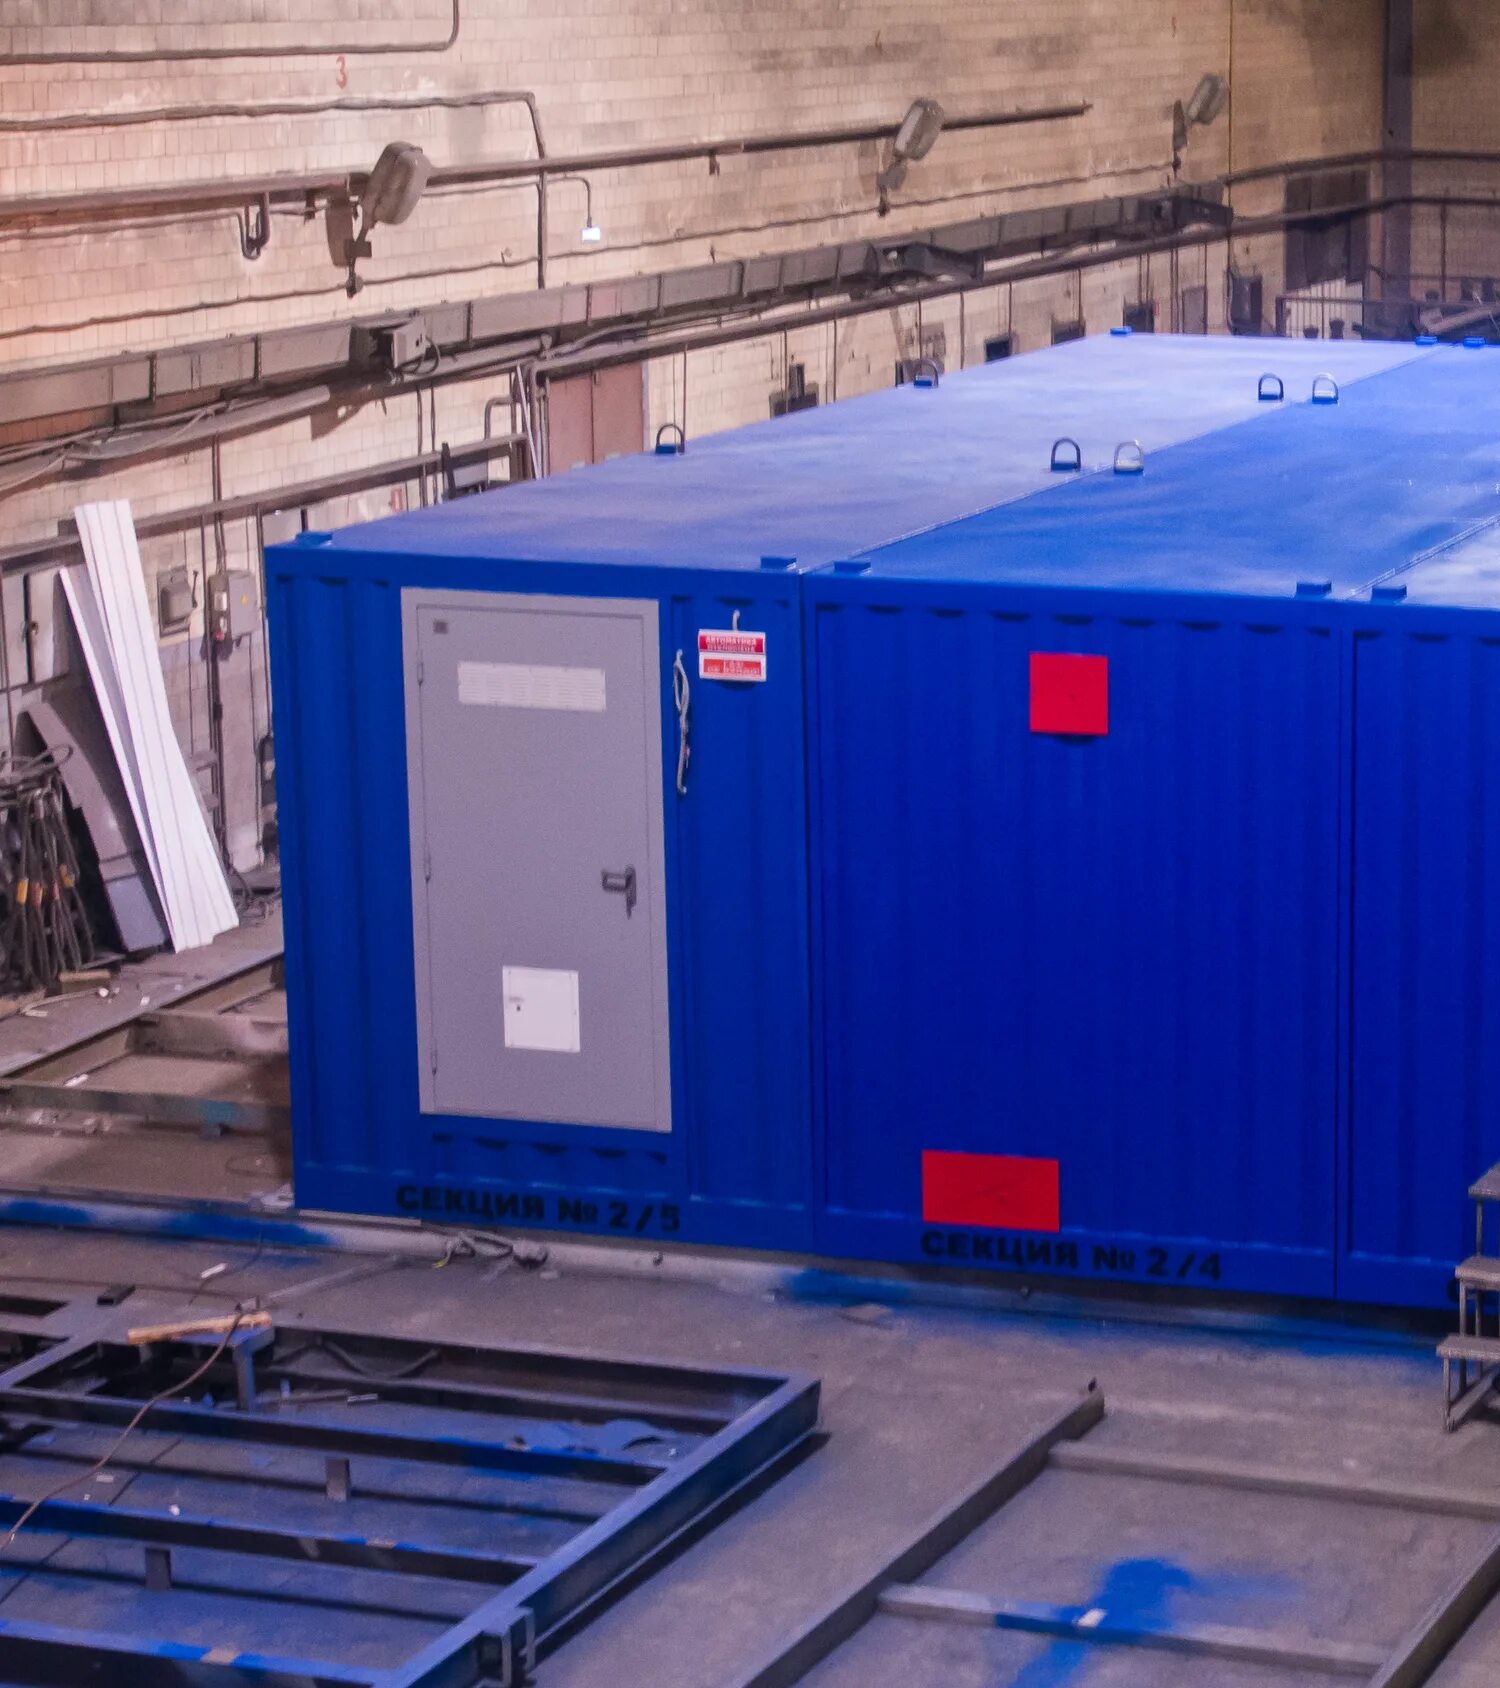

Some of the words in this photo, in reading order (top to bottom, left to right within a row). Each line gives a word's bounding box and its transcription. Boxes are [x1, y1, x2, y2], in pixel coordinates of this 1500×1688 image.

[395, 1185, 545, 1220] СЕКЦИЯ
[557, 1197, 598, 1224] №
[608, 1201, 680, 1232] 2/5
[920, 1230, 1080, 1268] СЕКЦИЯ
[1092, 1244, 1136, 1272] №
[1146, 1248, 1221, 1281] 2/4
